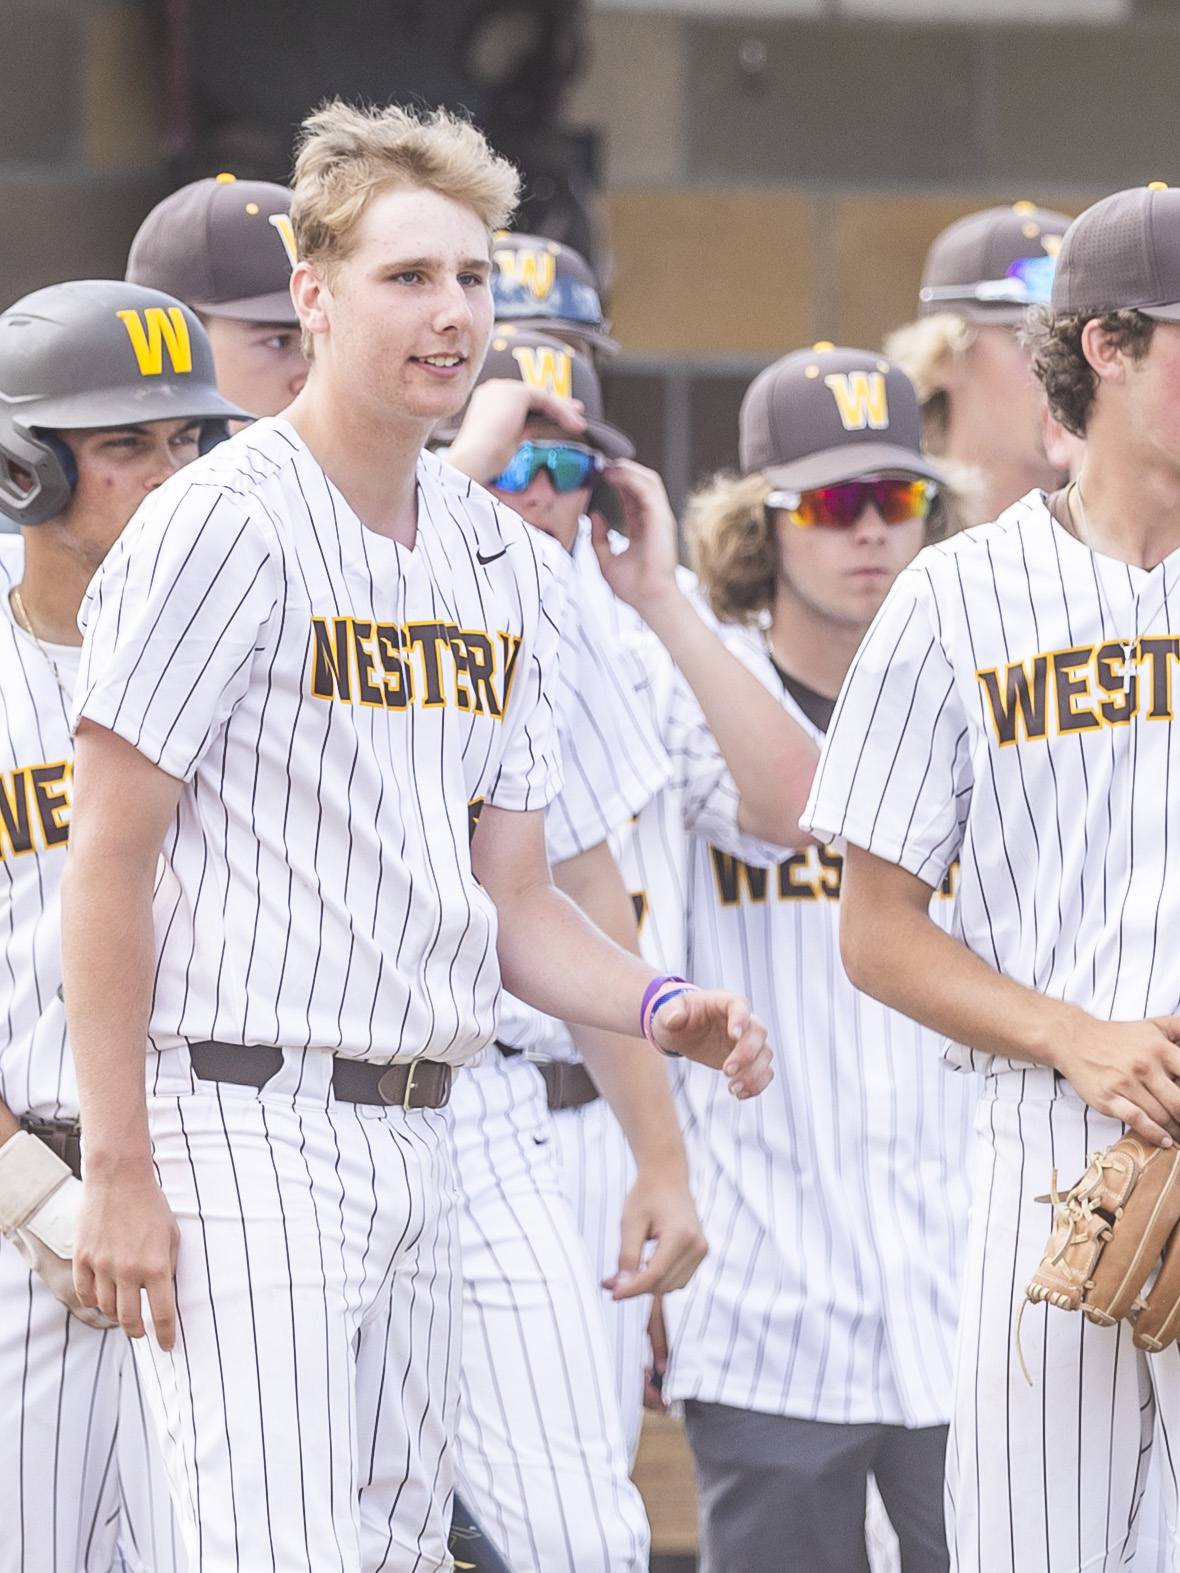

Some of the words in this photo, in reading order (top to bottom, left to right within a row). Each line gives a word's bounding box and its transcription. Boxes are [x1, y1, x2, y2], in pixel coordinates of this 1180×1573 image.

[117, 306, 193, 376] W
[512, 346, 572, 401] W
[825, 371, 890, 430] W
